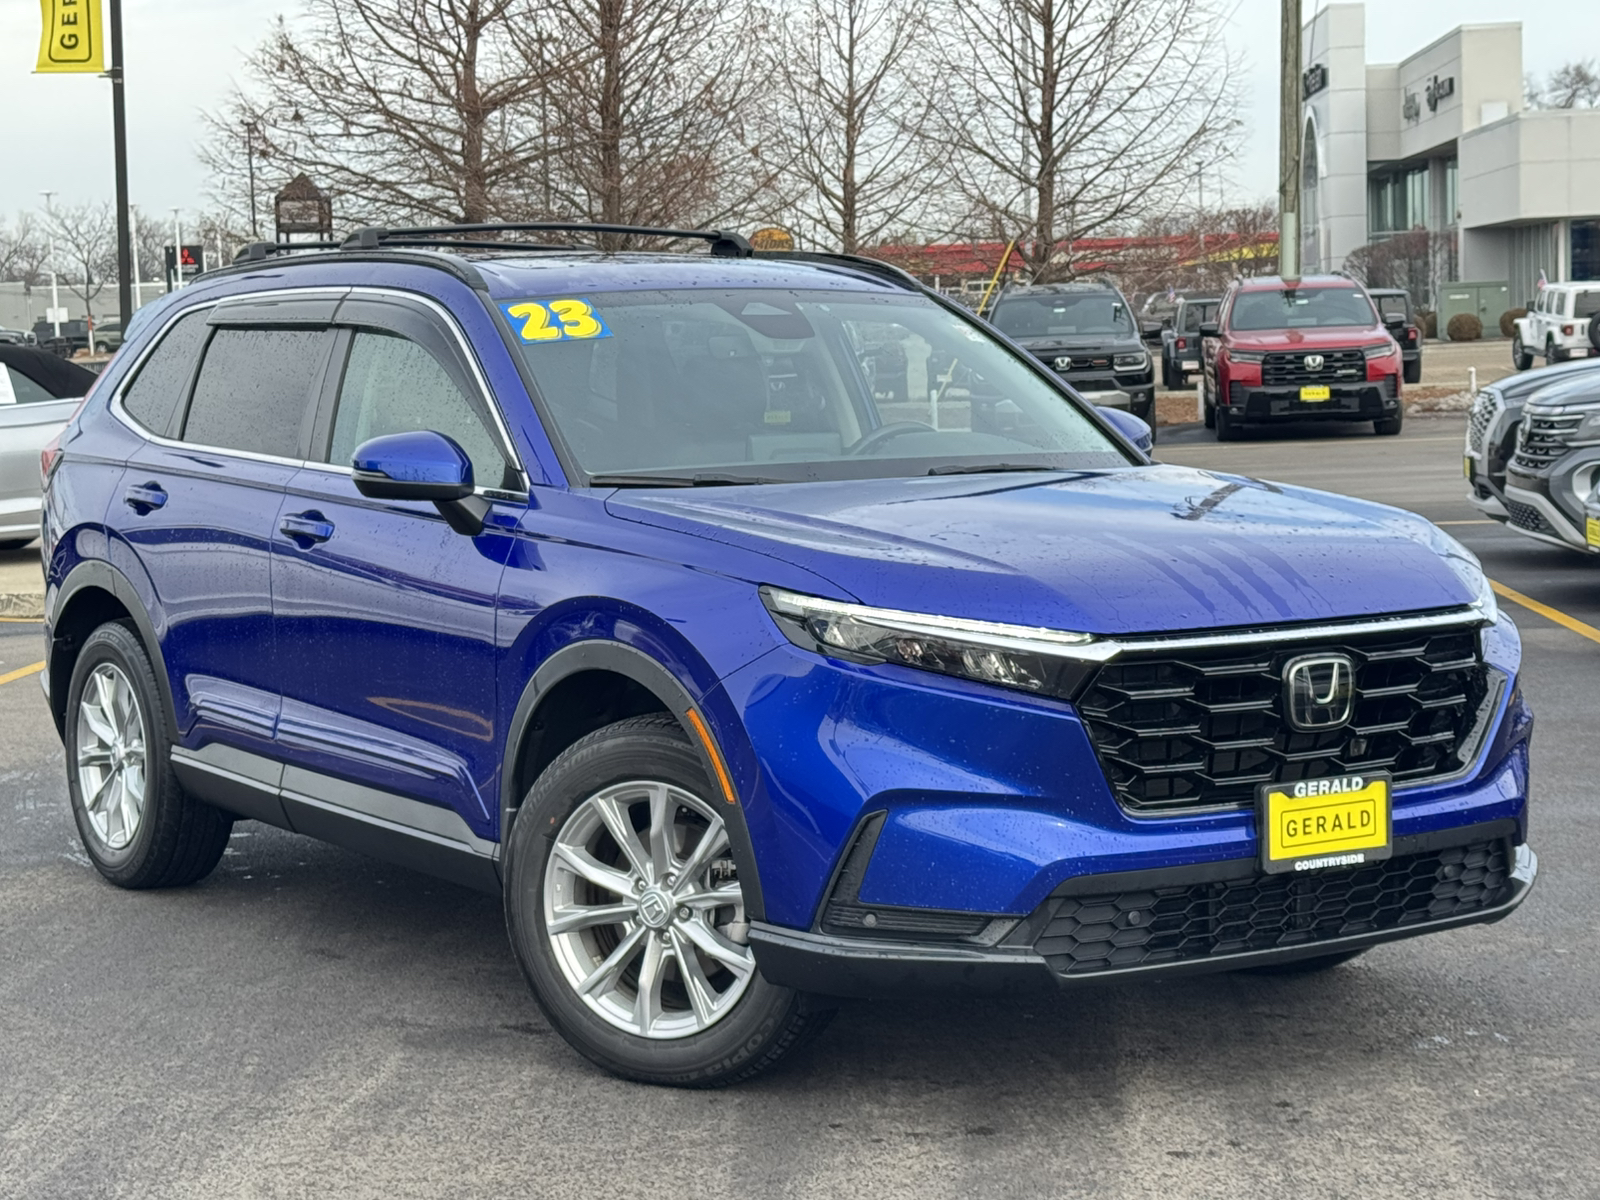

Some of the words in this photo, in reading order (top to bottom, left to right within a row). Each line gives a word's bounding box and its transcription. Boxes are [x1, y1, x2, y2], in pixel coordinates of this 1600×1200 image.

[508, 299, 602, 340] 23
[1294, 777, 1363, 798] GERALD
[1286, 810, 1371, 837] GERALD
[1295, 853, 1365, 871] COUNTRYSIDE
